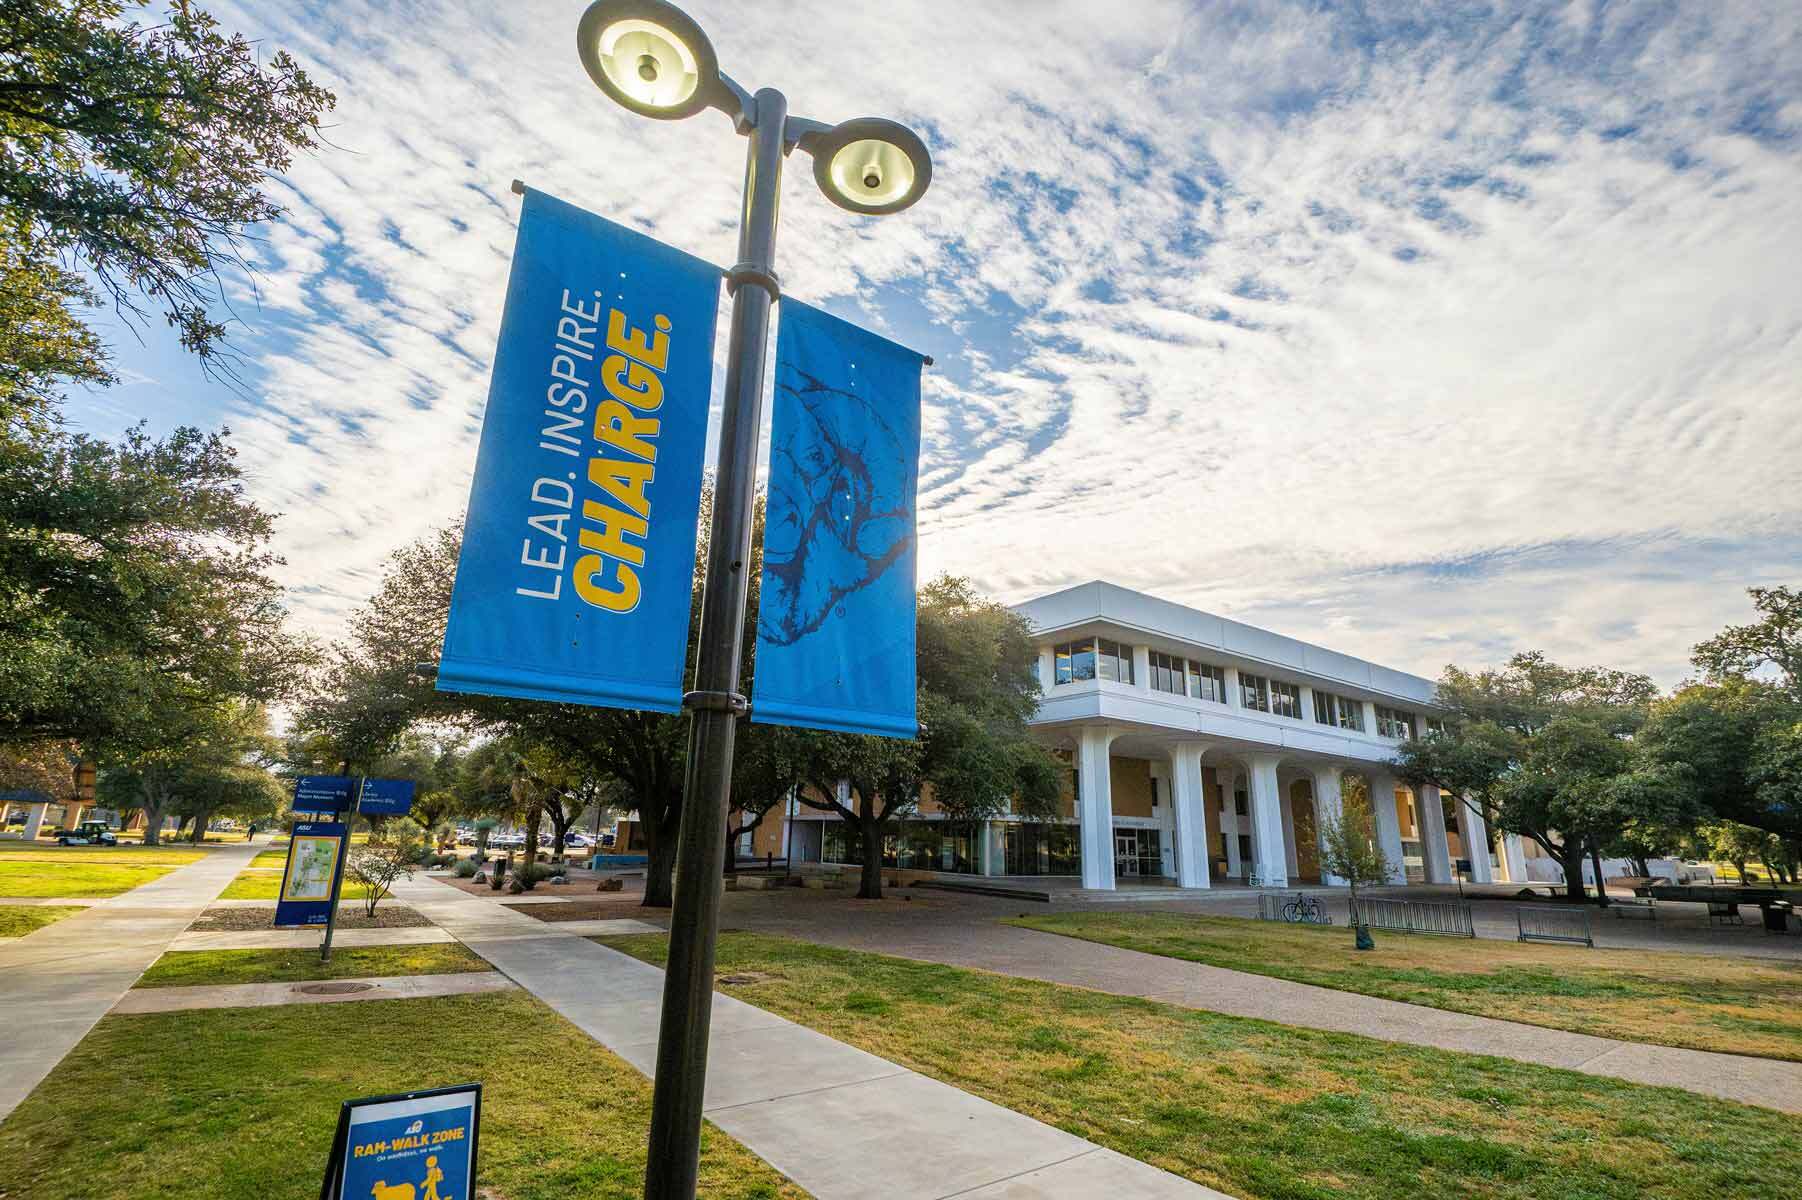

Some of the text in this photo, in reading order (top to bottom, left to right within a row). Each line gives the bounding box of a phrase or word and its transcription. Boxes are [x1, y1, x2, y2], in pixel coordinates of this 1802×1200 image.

[516, 288, 602, 601] LEAD. INSPIRE.
[572, 308, 673, 614] CHARGE.
[354, 1133, 430, 1158] RAM-WALK
[431, 1127, 465, 1145] ZONE
